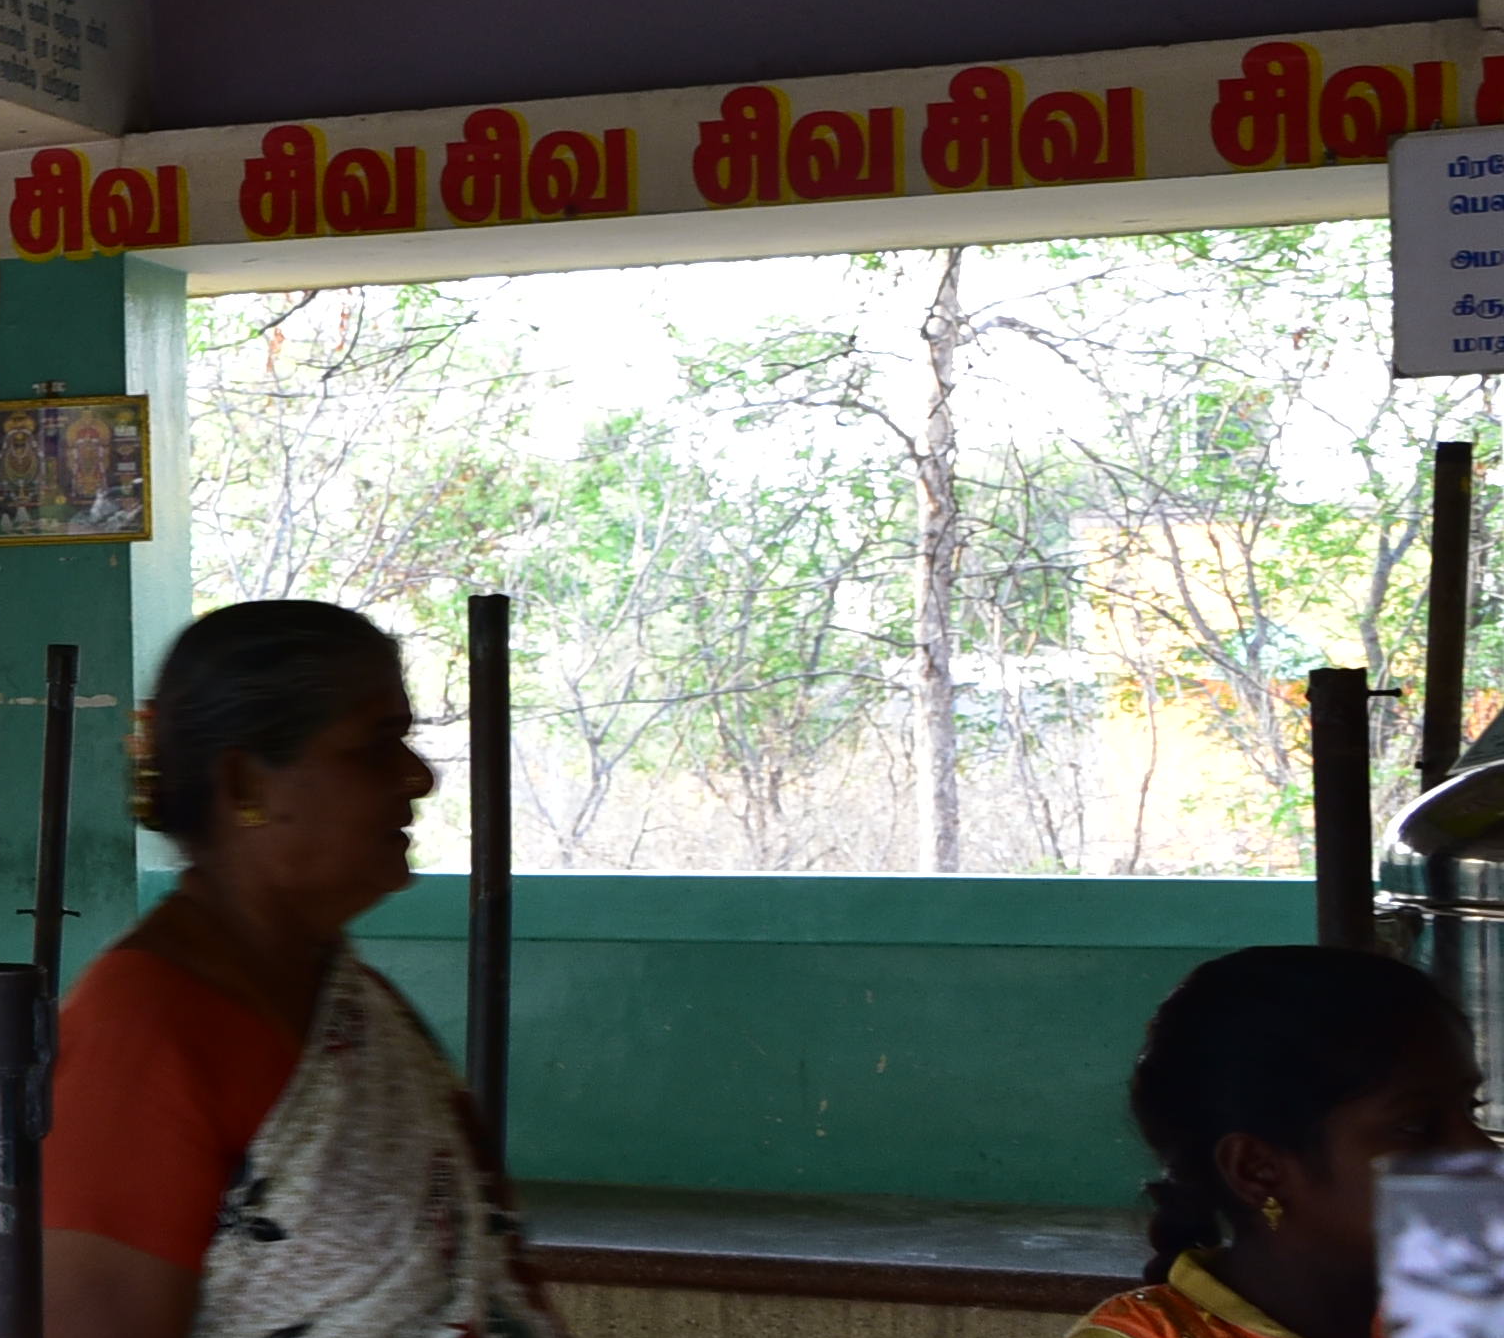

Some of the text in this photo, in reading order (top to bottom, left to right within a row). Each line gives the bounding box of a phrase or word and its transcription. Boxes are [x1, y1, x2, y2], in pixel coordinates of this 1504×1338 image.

[11, 150, 179, 254] சிவ
[242, 126, 419, 234] சிவ
[444, 109, 630, 219] சிவ
[696, 88, 895, 199] சிவ
[925, 68, 1136, 183] சிவ
[1211, 41, 1447, 166] சிவ
